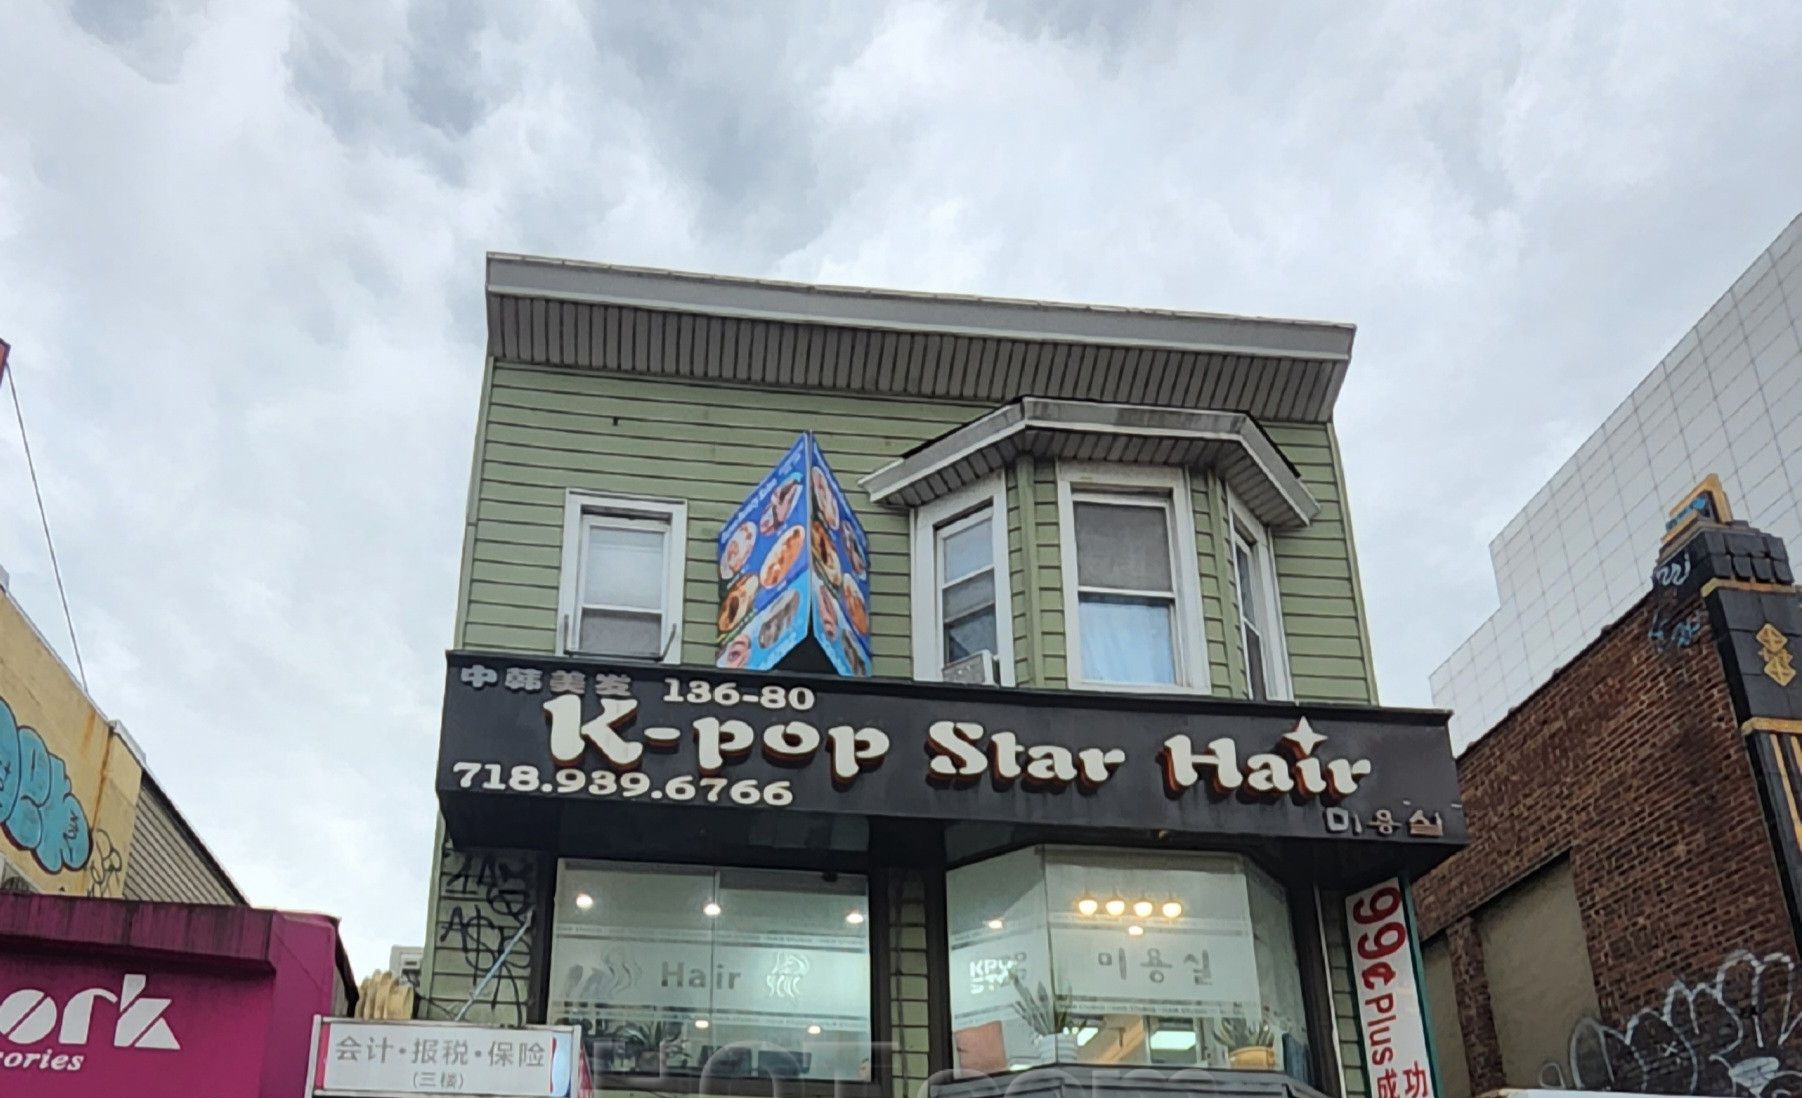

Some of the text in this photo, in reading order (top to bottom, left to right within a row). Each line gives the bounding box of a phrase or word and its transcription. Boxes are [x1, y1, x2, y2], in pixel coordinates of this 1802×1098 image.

[663, 678, 815, 711] 136-80
[543, 694, 1371, 800] K-pop Star Hair
[453, 761, 793, 806] 718.939.6766
[660, 961, 741, 991] Hair
[1364, 992, 1397, 1066] Plus
[0, 1048, 84, 1071] ories
